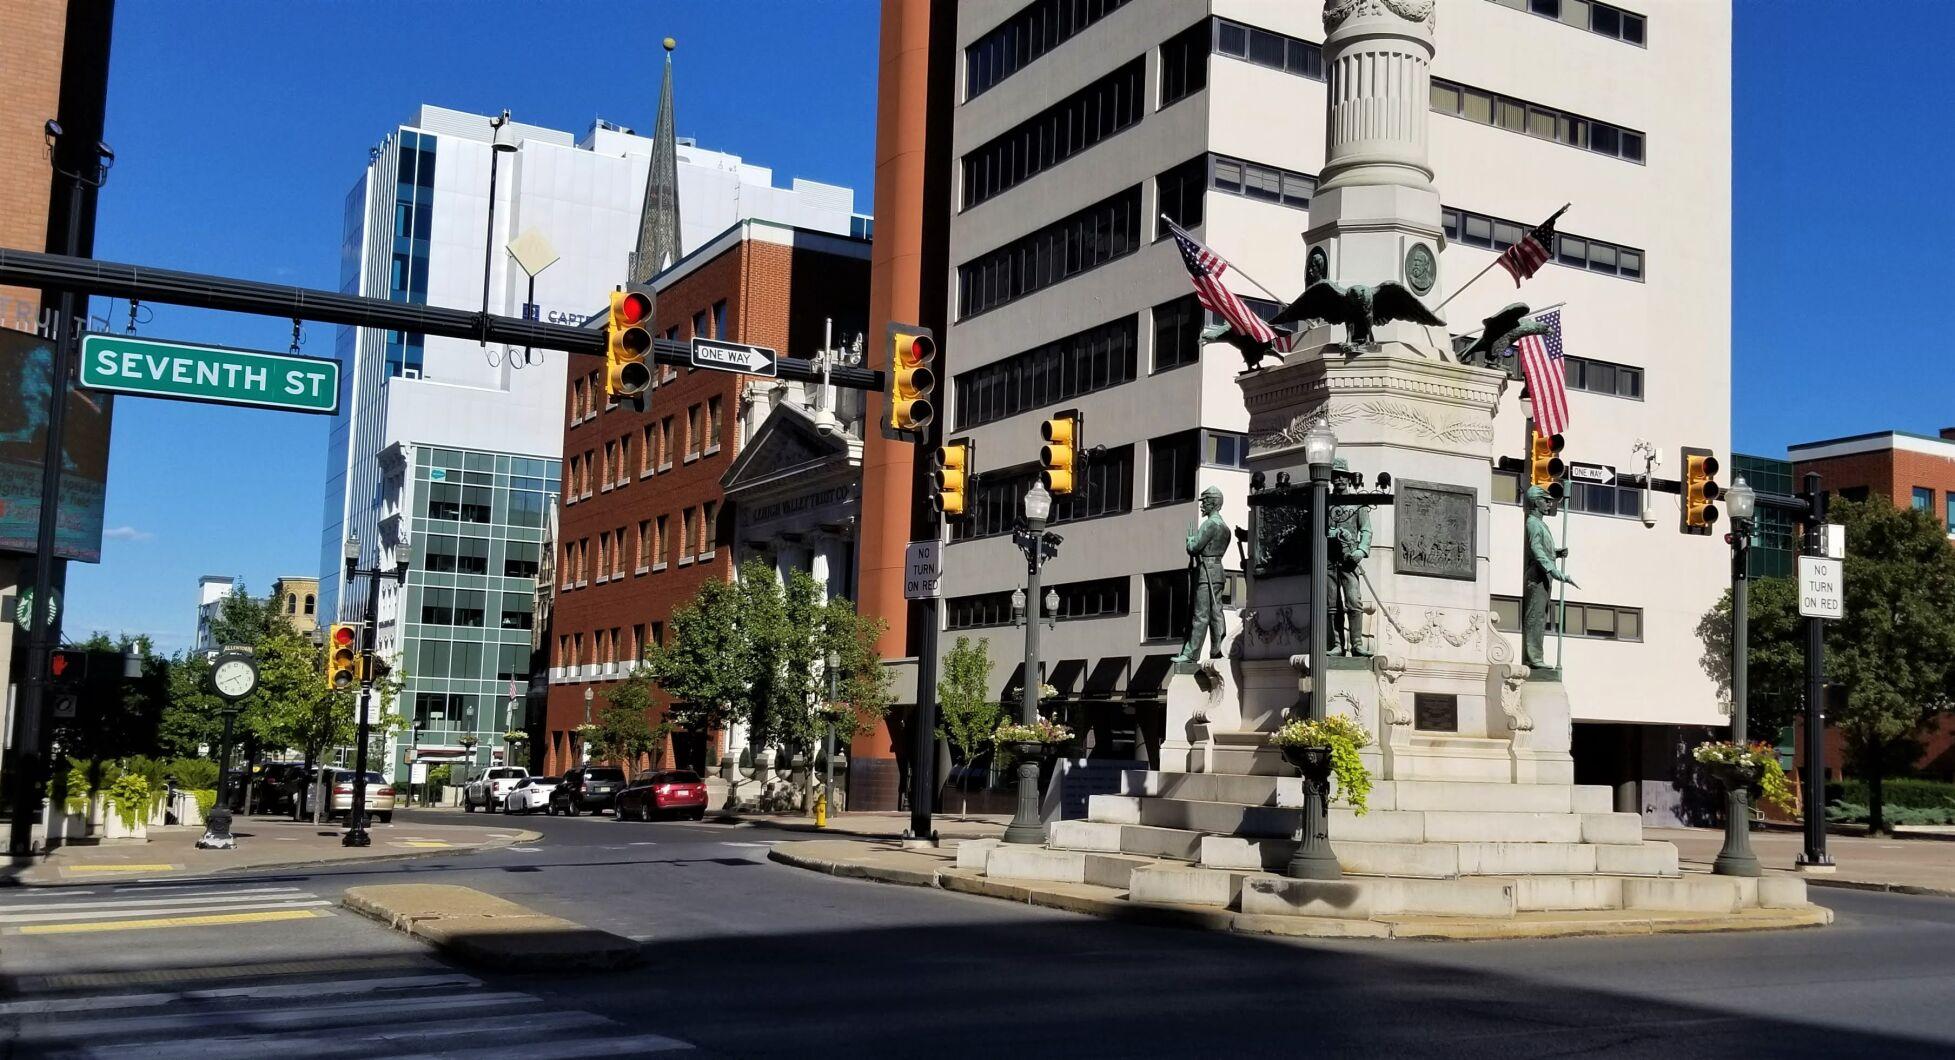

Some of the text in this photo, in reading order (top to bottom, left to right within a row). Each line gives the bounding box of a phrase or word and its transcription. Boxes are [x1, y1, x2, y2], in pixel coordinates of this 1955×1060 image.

[701, 348, 751, 364] ONE WAY
[96, 350, 326, 397] SEVENTH ST
[1574, 467, 1588, 477] ONE
[919, 547, 930, 559] NO
[913, 563, 935, 575] TURN
[1814, 564, 1827, 576] NO
[908, 580, 939, 592] ON RED
[1808, 580, 1833, 592] TURN
[1804, 596, 1838, 610] ON RED
